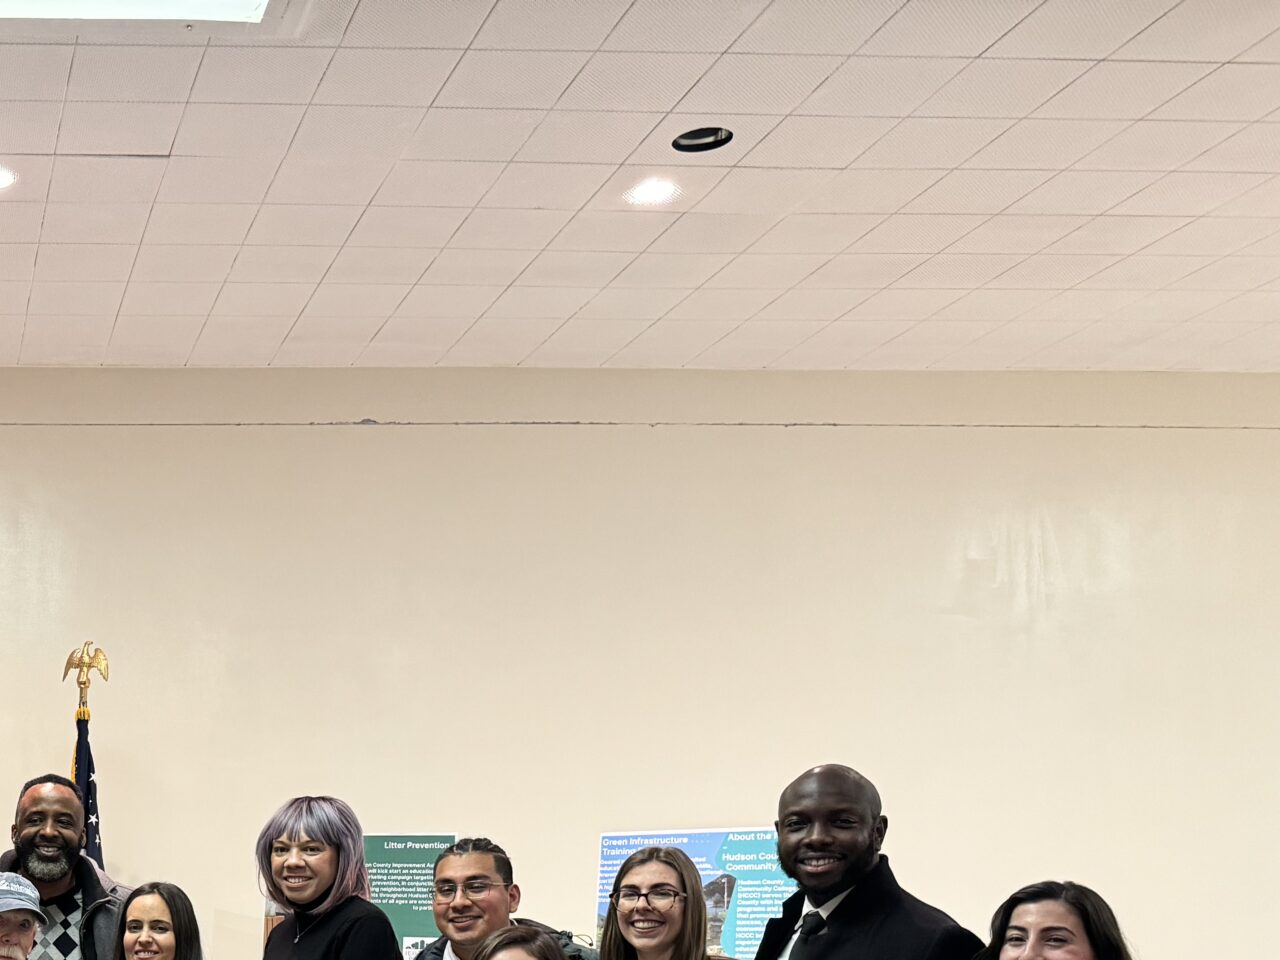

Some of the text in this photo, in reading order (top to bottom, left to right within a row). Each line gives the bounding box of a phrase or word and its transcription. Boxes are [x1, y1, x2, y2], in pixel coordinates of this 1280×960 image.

[728, 832, 754, 840] About
[756, 832, 771, 840] the
[630, 837, 688, 845] Infrastructure
[722, 853, 756, 861] Hudson
[726, 862, 778, 872] Community
